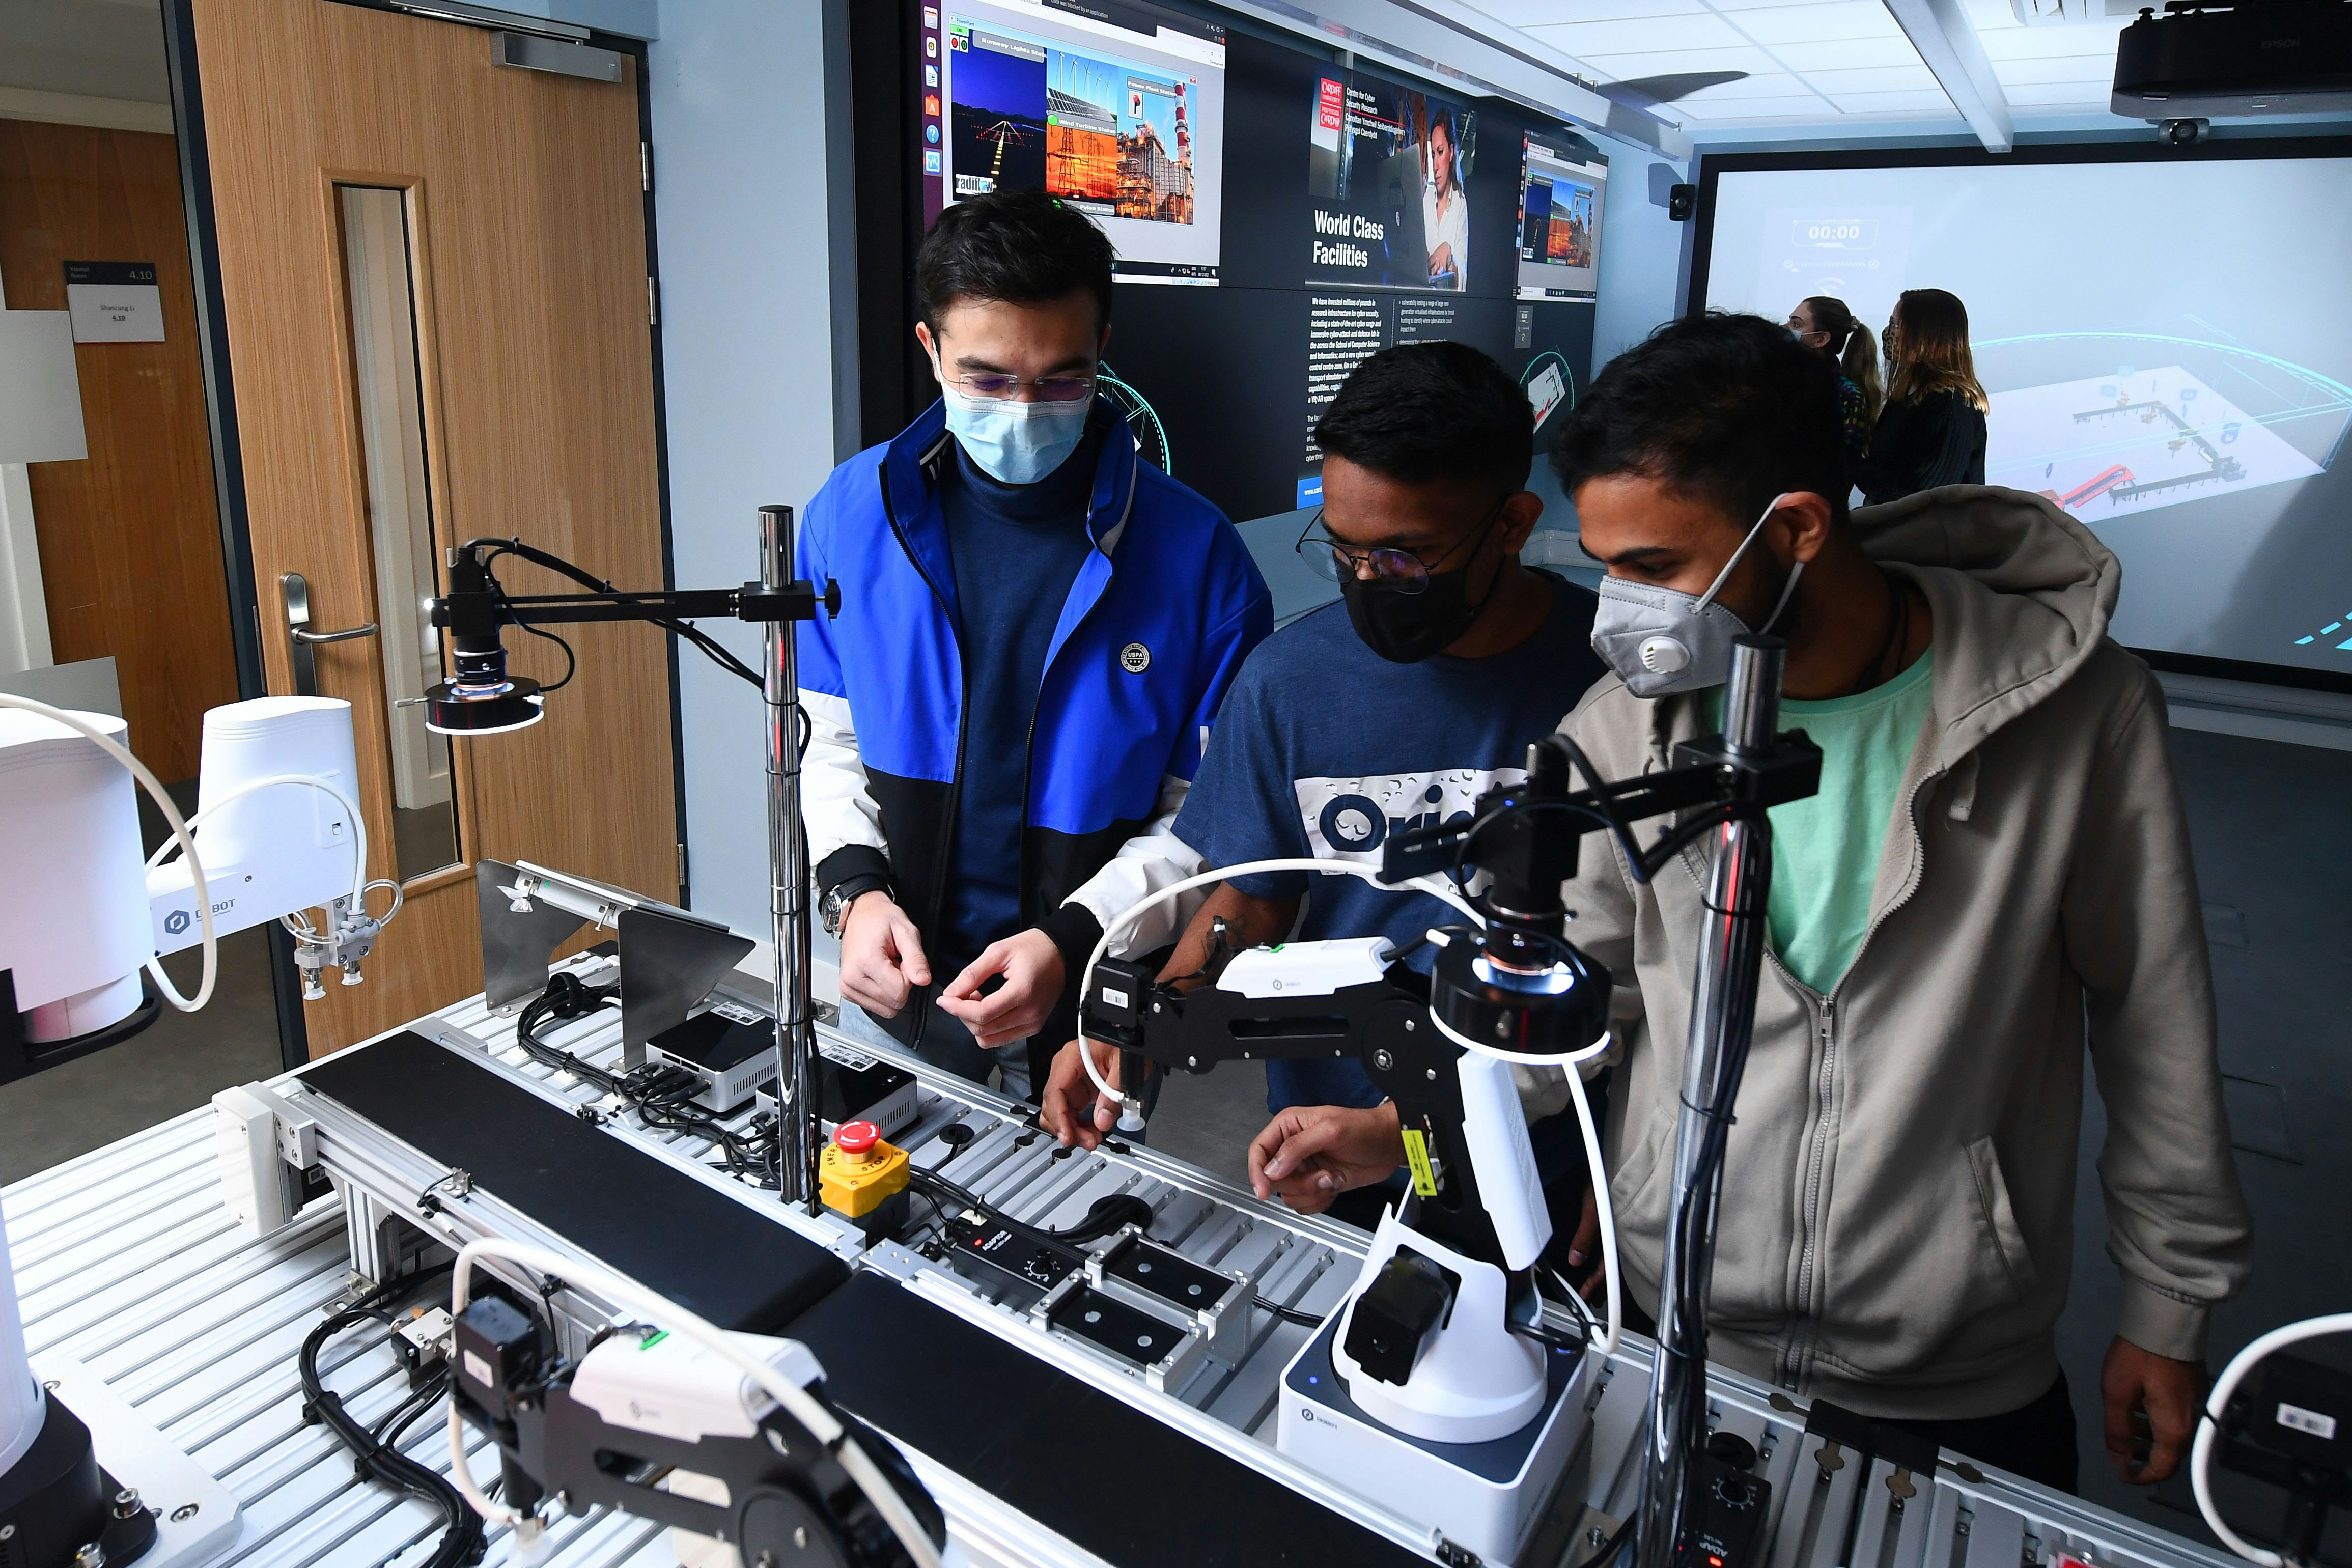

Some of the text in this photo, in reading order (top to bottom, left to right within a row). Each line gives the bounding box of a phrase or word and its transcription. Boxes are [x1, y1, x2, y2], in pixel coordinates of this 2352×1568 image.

[981, 37, 1009, 49] Runway
[1010, 45, 1030, 54] Lights
[2260, 39, 2301, 49] EPSON
[1128, 80, 1178, 97] Power Plant Station
[1346, 87, 1359, 98] Centre
[1364, 93, 1376, 103] Cyber
[1346, 98, 1378, 115] Security Research
[1058, 119, 1074, 127] Wind
[1075, 122, 1097, 131] Turbine
[1314, 210, 1384, 240] World Class
[1809, 226, 1860, 239] 00:00
[1313, 241, 1368, 267] Facilities
[129, 270, 153, 280] 4.10
[1312, 297, 1319, 305] We
[1328, 309, 1351, 317] infrastructure
[1356, 310, 1365, 318] cyber
[1311, 319, 1328, 329] including
[1356, 320, 1365, 328] cyber
[1310, 330, 1329, 338] immersive
[1329, 330, 1351, 340] cyber-attack
[1357, 329, 1370, 338] defence
[1335, 340, 1348, 348] School
[1351, 340, 1367, 349] Computer
[1367, 340, 1380, 348] Science
[1355, 351, 1365, 359] cyber
[1309, 362, 1323, 371] control
[1308, 374, 1326, 383] transport
[1326, 373, 1342, 381] simulator
[195, 898, 236, 918] DBOT
[861, 1156, 885, 1172] STOP
[982, 1230, 1008, 1251] ADAPTOR
[1699, 1542, 1729, 1557] ADAP
